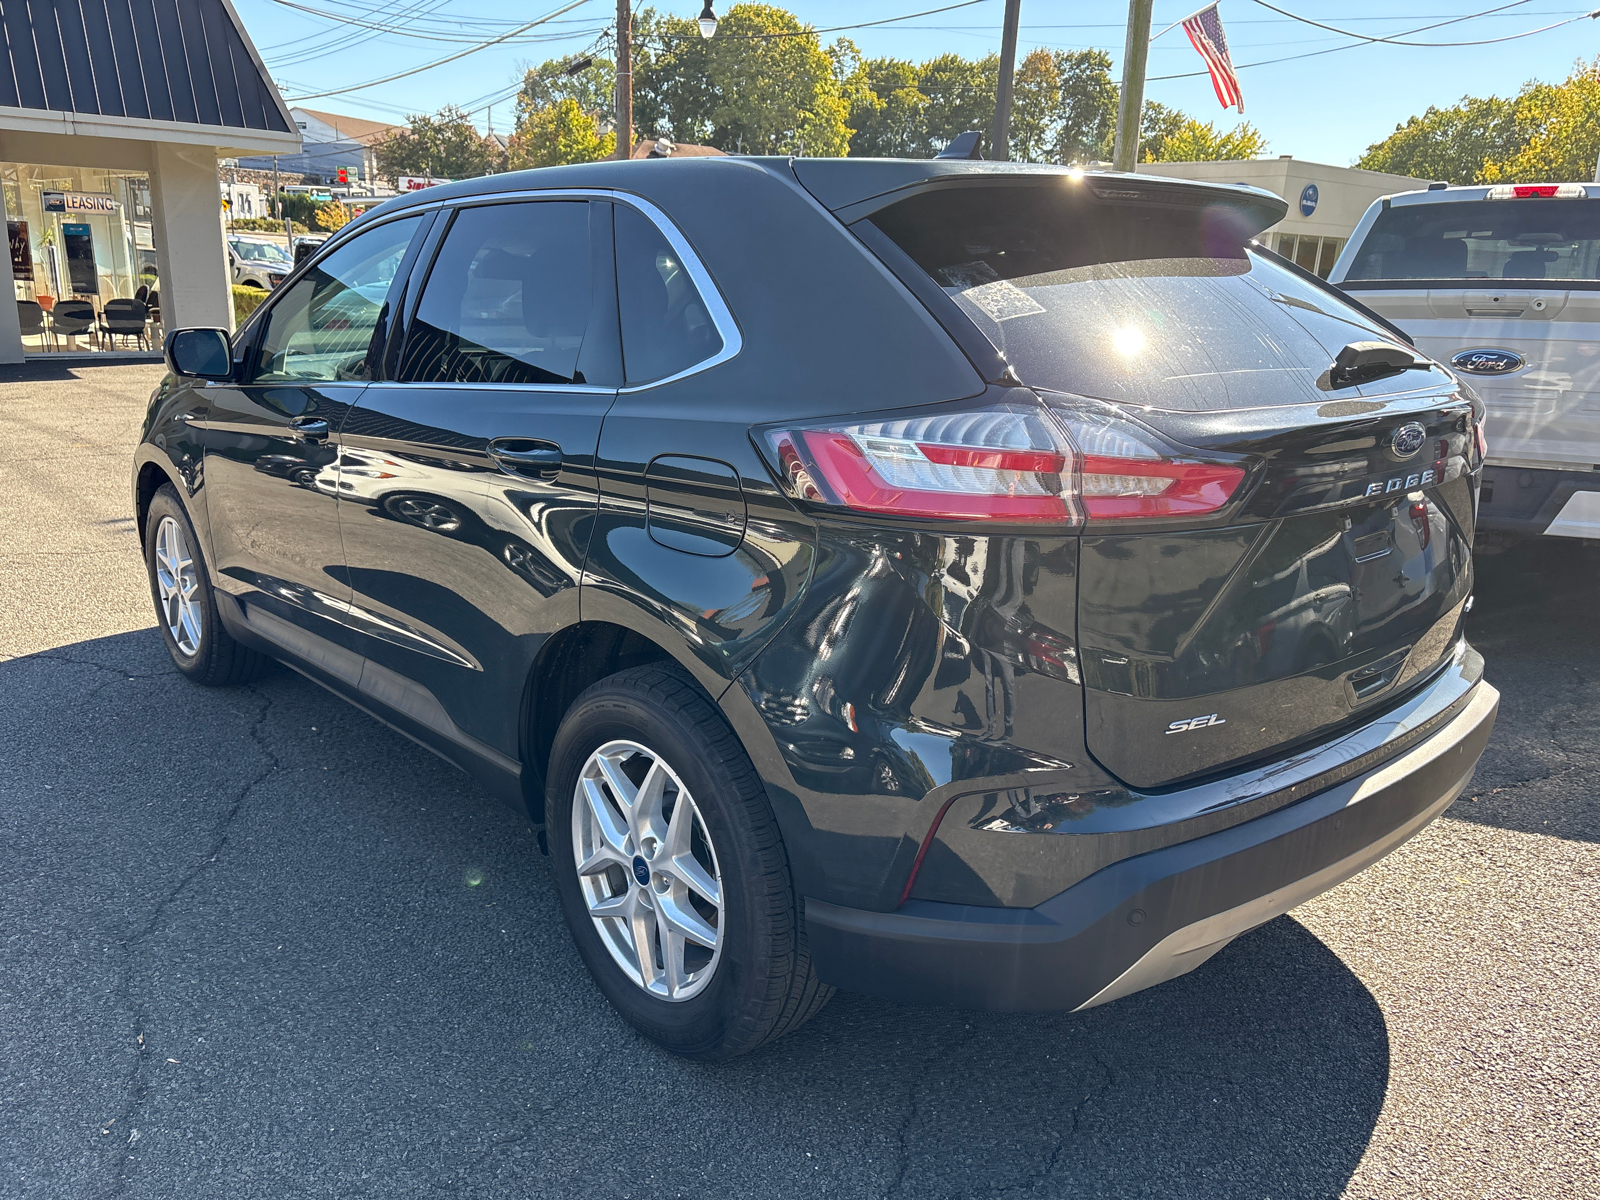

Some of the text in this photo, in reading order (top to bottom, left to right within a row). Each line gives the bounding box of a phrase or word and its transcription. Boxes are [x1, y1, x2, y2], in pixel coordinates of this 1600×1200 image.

[66, 196, 114, 211] LEASING
[1467, 354, 1508, 370] Ford
[1365, 469, 1435, 497] EDGE
[1165, 713, 1226, 735] SEL
